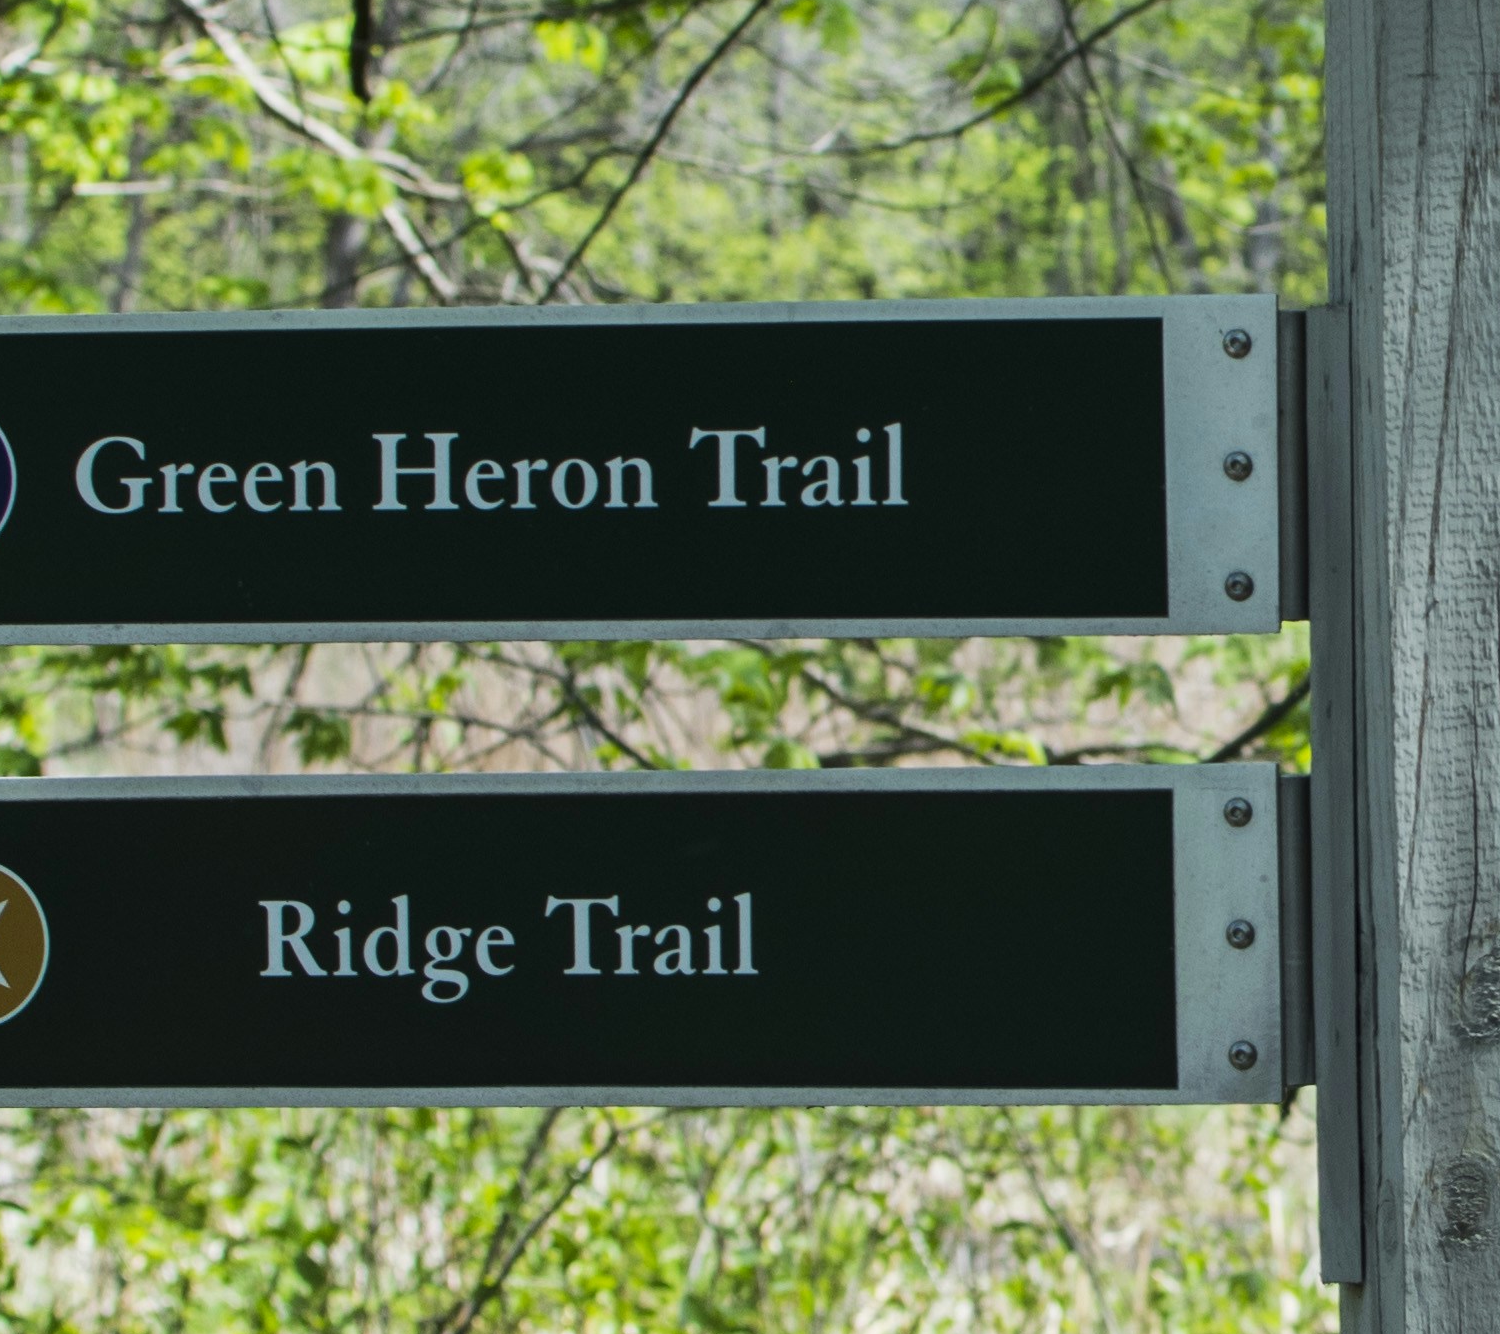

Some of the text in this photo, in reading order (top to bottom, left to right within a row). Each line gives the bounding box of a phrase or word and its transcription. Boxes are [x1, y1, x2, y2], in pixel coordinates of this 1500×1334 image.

[74, 421, 909, 515] Green Heron Trail
[257, 891, 759, 1004] Ridge Trail
